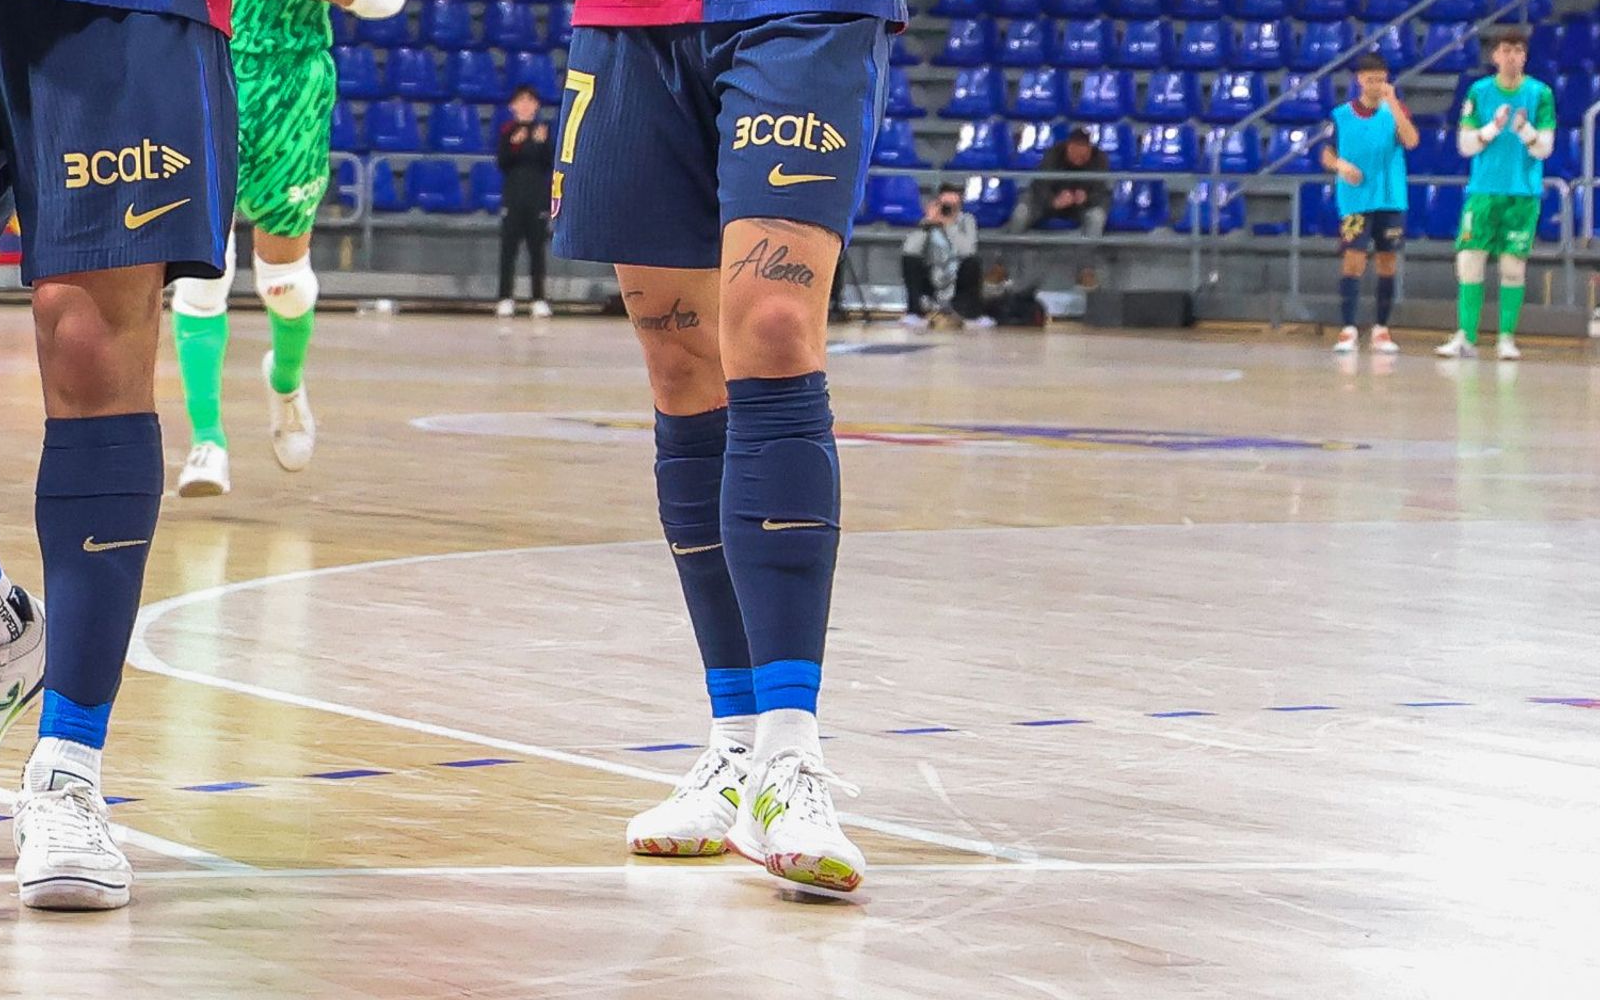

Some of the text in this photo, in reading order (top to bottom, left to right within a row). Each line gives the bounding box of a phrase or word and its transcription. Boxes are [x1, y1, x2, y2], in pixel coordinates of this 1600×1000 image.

[560, 69, 596, 163] 7
[732, 112, 821, 151] 3cat
[63, 138, 160, 189] 3cat
